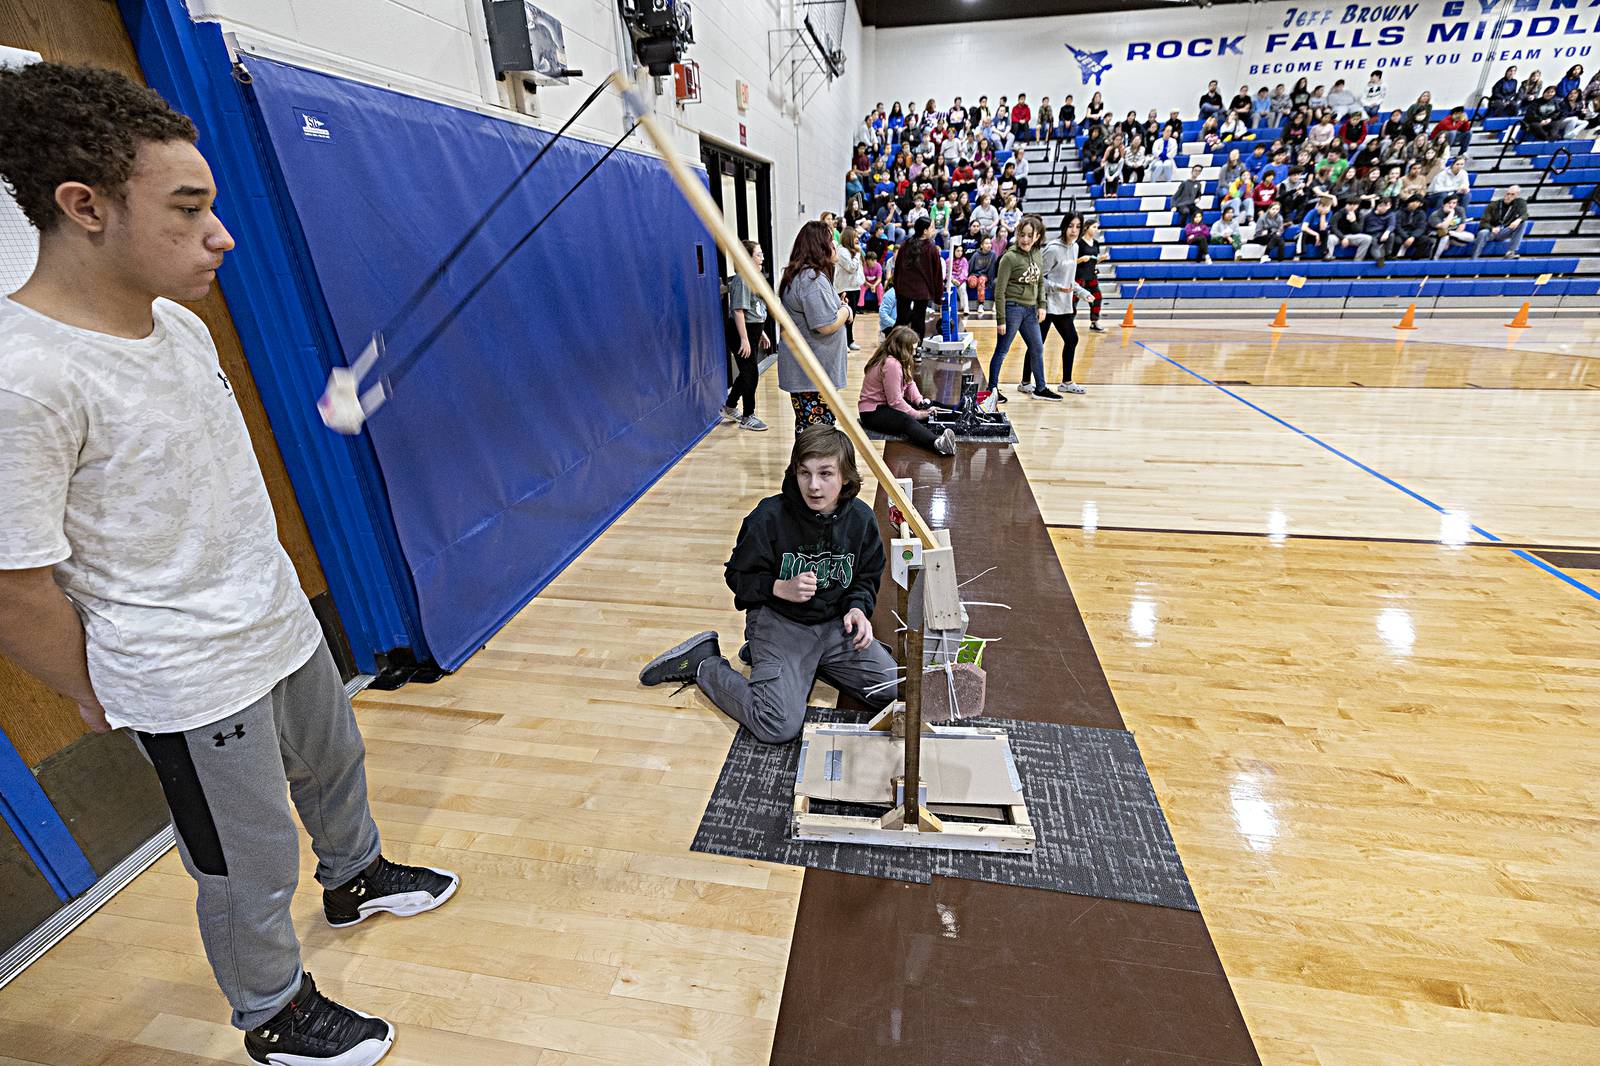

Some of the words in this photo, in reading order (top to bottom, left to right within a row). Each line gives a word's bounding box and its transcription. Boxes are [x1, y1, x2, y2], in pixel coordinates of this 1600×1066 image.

[1126, 34, 1247, 62] ROCK
[1265, 26, 1405, 54] FALLS
[1426, 14, 1600, 44] MIDDL
[1249, 60, 1324, 76] BECOME
[1335, 58, 1367, 71] THE
[1376, 55, 1414, 69] ONE
[1425, 52, 1461, 65] YOU
[1471, 48, 1542, 63] DREAM
[1553, 45, 1592, 59] YOU
